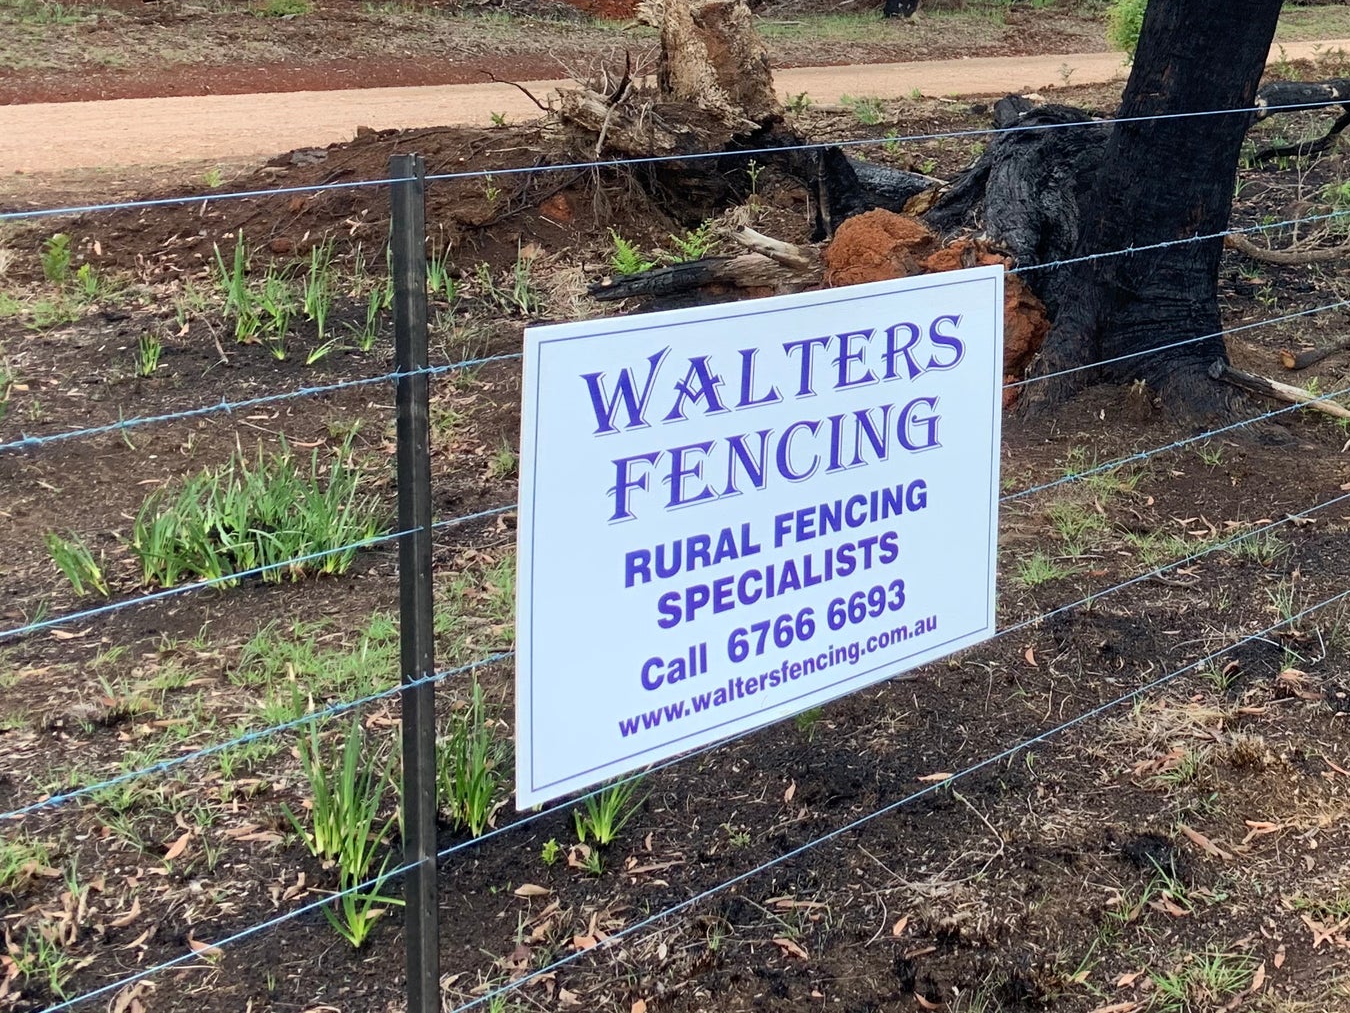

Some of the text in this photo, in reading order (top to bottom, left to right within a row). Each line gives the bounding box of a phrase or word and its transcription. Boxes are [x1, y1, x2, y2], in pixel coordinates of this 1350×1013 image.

[580, 314, 966, 437] WALTERS
[607, 396, 942, 524] FENCING
[624, 479, 928, 587] RURAL FENCING
[657, 530, 899, 629] SPECIALISTS
[618, 612, 938, 737] www.waltersfencing.com.au
[641, 579, 905, 691] Call 6766 6693
